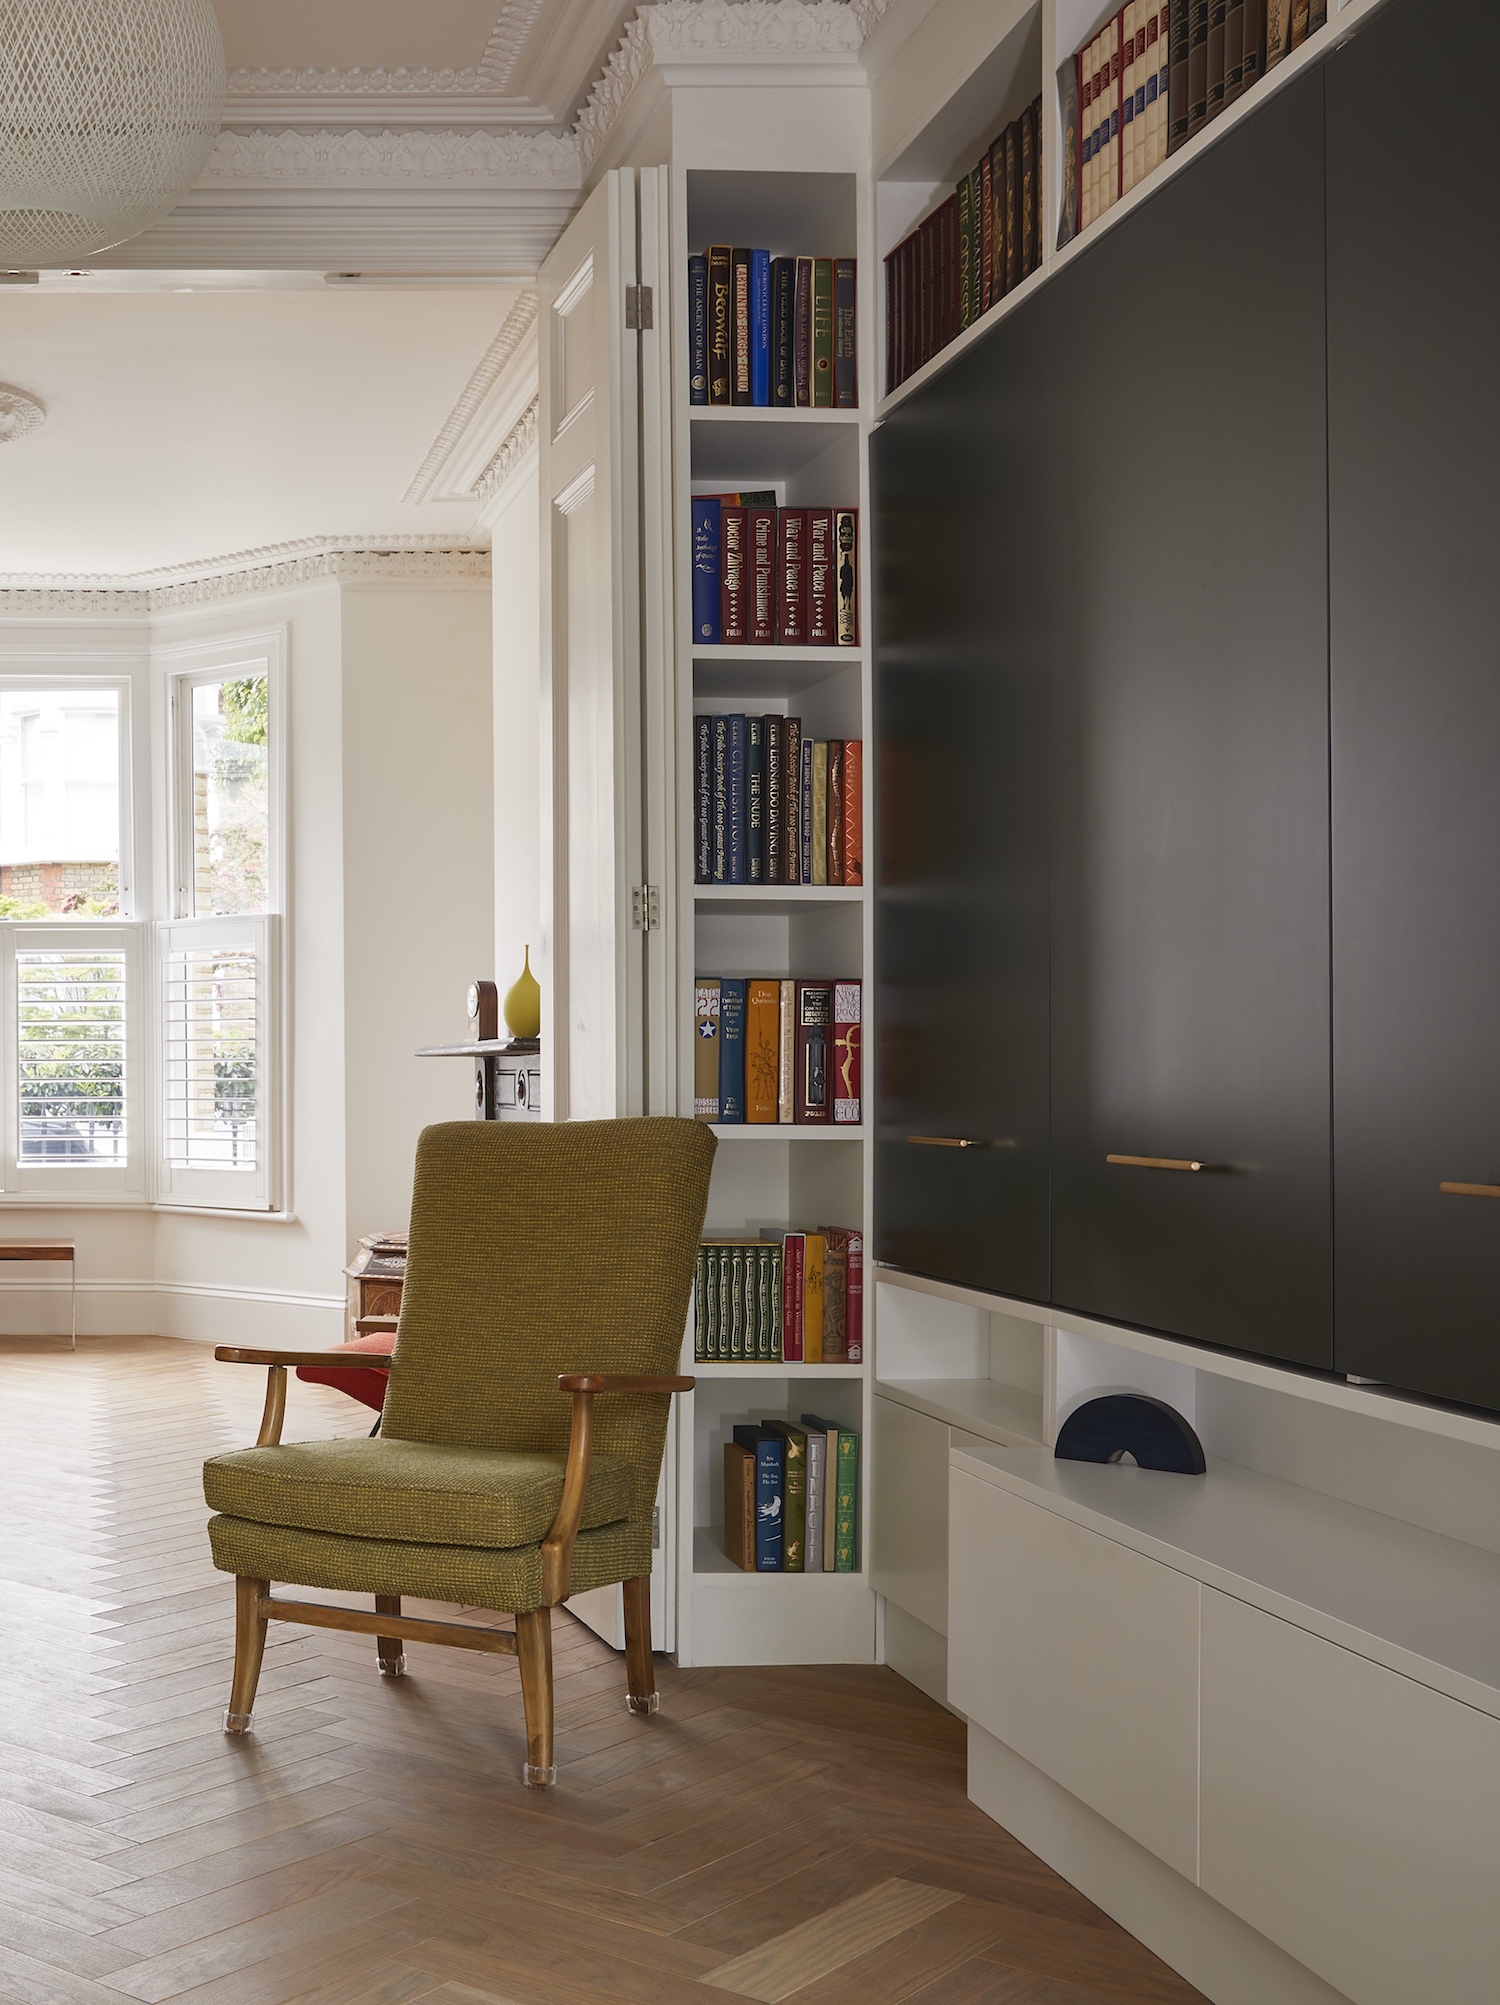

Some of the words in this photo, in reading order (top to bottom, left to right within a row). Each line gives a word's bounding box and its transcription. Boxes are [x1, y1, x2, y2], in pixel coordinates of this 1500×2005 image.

[960, 184, 969, 225] THE
[982, 164, 991, 243] HOMER
[695, 277, 704, 296] THE
[736, 265, 748, 319] LABYRINTHS
[780, 270, 789, 289] THE
[960, 234, 969, 330] ODYSSEY
[982, 253, 991, 311] ILIAD
[695, 298, 704, 333] ASCENT
[780, 292, 789, 318] FOLIO
[815, 295, 831, 338] LIFE
[844, 307, 854, 327] The
[712, 282, 729, 361] Beowulf
[780, 320, 789, 344] BOOK
[695, 335, 704, 347] OF
[736, 325, 748, 358] BORGES
[780, 346, 789, 357] OF
[844, 329, 854, 358] Earth
[695, 350, 704, 371] MAN
[780, 359, 789, 380] DAYS
[736, 363, 748, 390] FOLIO
[727, 518, 742, 550] Doctor
[756, 519, 771, 546] Crime
[786, 518, 801, 540] War
[813, 518, 828, 541] War
[756, 548, 771, 565] and
[786, 542, 801, 561] and
[813, 543, 828, 561] and
[724, 552, 742, 591] Zhivago
[786, 563, 801, 591] Peace
[813, 564, 828, 591] Peace
[756, 567, 771, 622] Punishment
[751, 772, 761, 795] THE
[770, 749, 780, 808] LEONARDO
[732, 750, 743, 853] CIVILISATION
[751, 797, 761, 829] NUDE
[695, 988, 721, 998] CATCH
[697, 998, 720, 1017] 22
